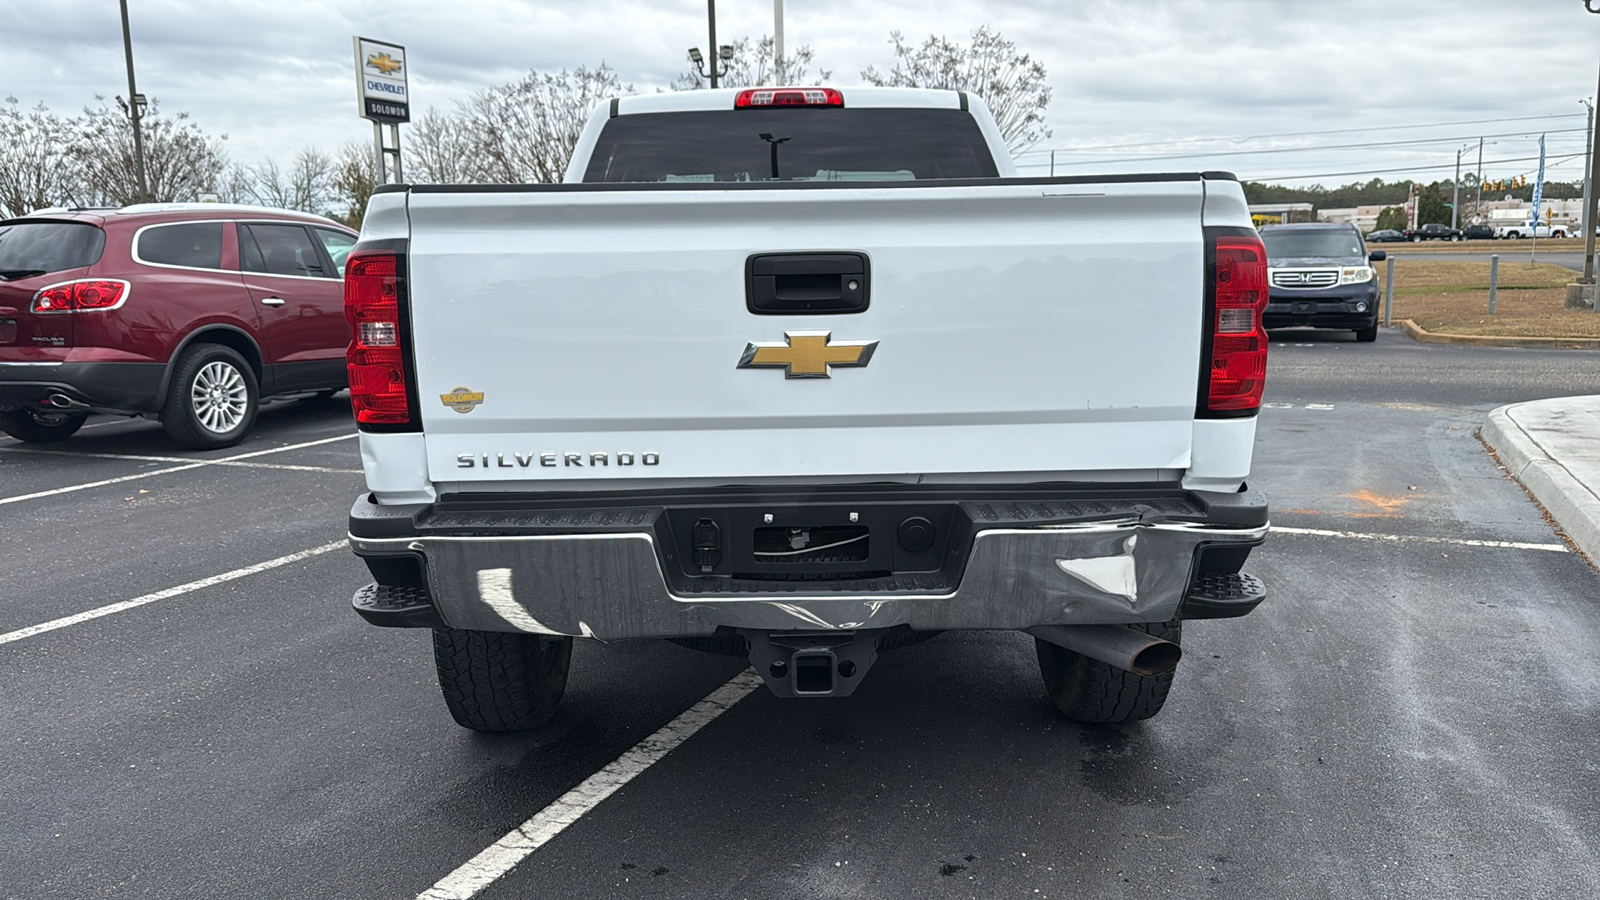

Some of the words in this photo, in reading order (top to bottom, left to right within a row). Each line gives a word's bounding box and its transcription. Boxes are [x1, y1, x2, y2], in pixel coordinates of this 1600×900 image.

[367, 80, 405, 95] CHEVROLET
[371, 103, 406, 117] SOLOMON
[442, 393, 483, 402] SOLOMON
[457, 451, 660, 468] SILVERADO
